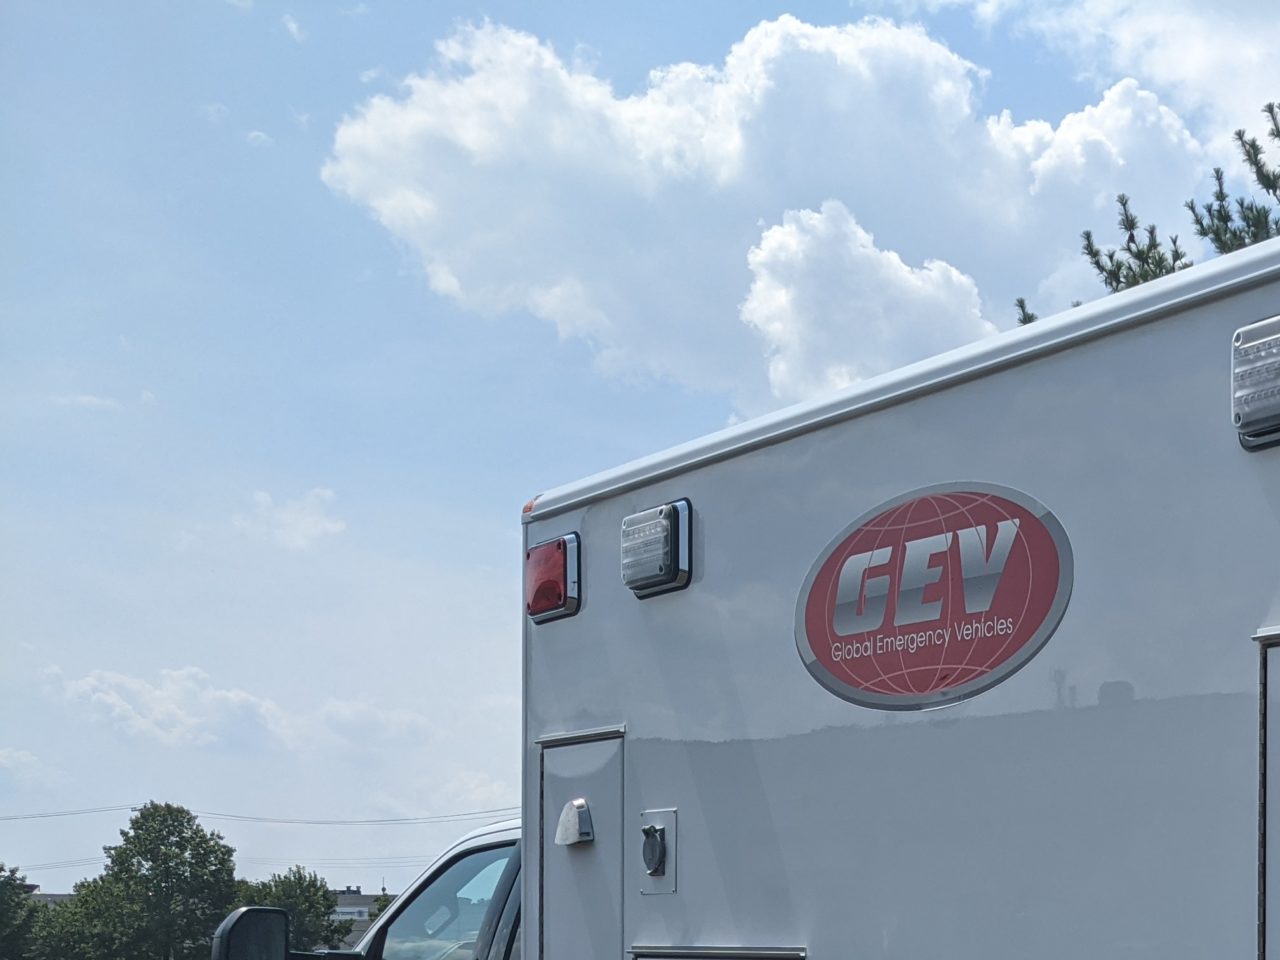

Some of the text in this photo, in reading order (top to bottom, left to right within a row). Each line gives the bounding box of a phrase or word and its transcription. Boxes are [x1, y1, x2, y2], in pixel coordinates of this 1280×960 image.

[833, 518, 1020, 637] GEV
[831, 617, 1013, 661] Global Emergency Vehicles
